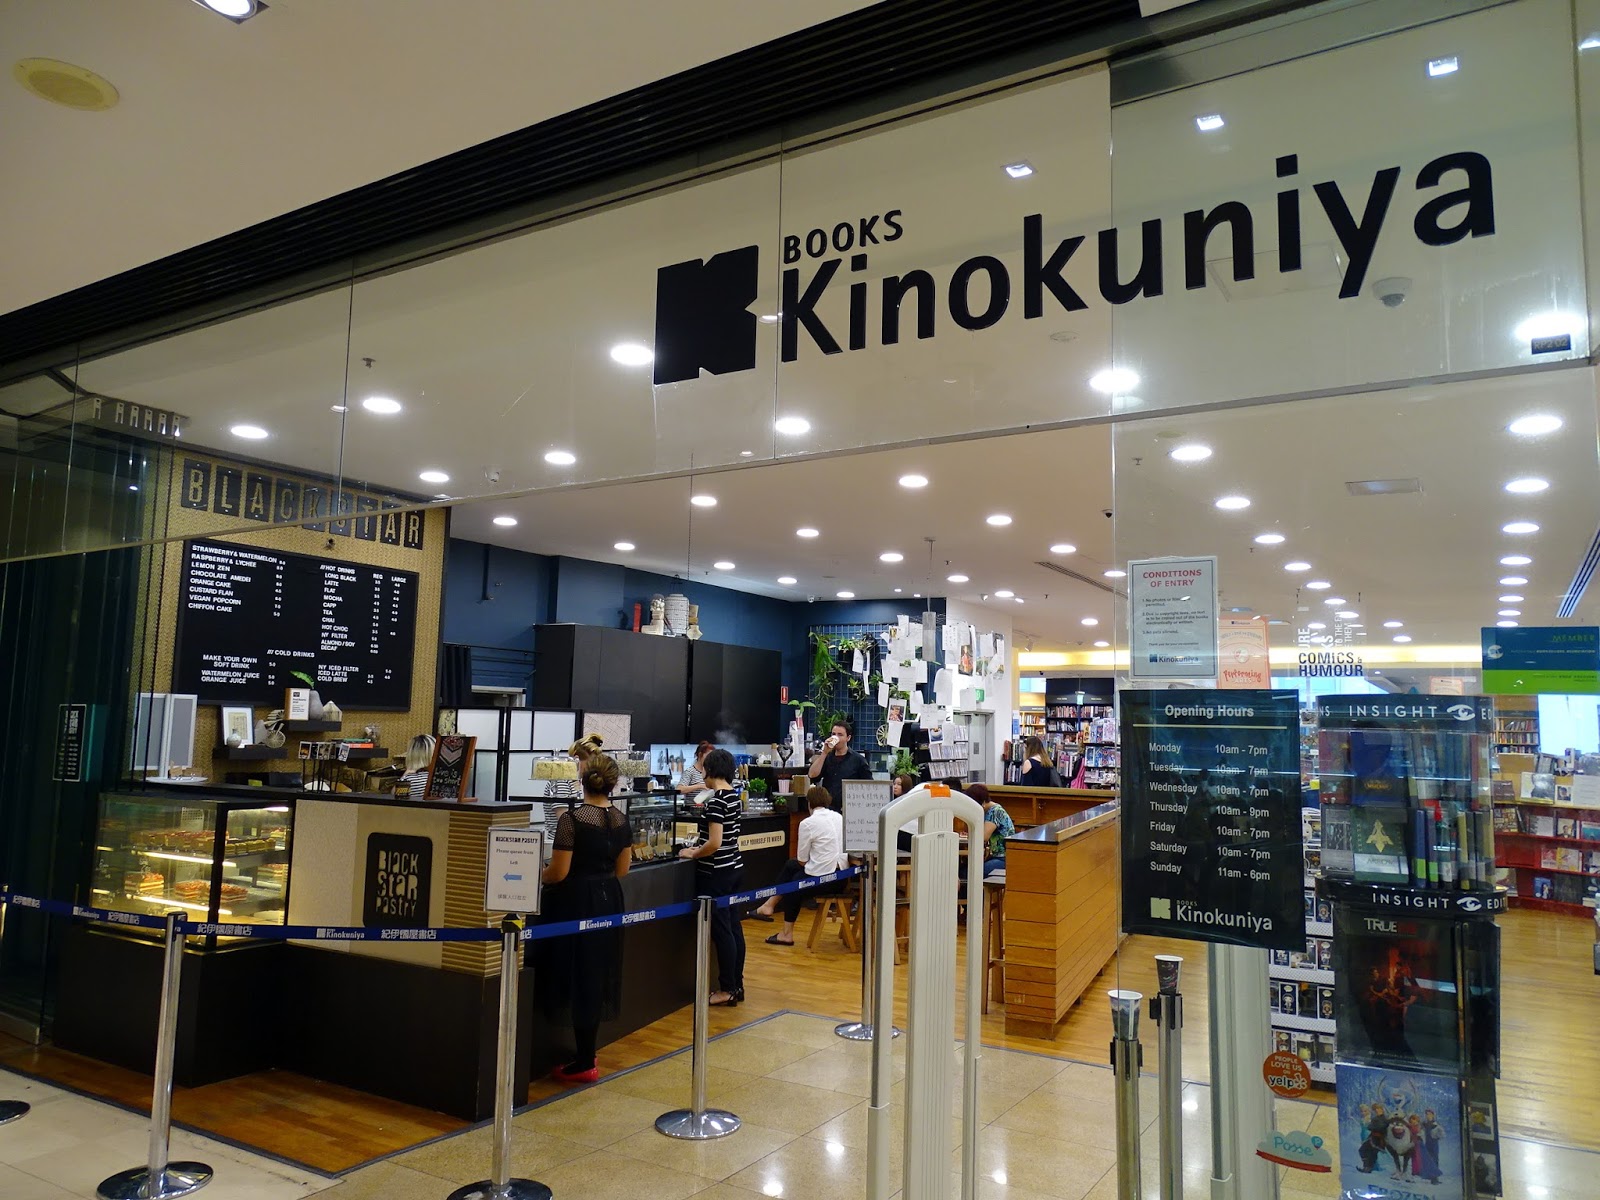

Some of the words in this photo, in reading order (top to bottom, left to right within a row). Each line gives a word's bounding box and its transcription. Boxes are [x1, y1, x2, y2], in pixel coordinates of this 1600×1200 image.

[783, 209, 904, 265] BOOKS
[780, 150, 1496, 364] Kinokuniya
[239, 551, 277, 563] WATERMELON
[191, 561, 215, 570] LEMON
[235, 560, 257, 568] LYCHEE
[190, 570, 227, 579] CHOCOLATE
[230, 574, 251, 582] AMEDEI
[324, 572, 339, 580] LONG
[340, 574, 357, 582] BLACK
[1142, 569, 1202, 579] CONDITIONS
[189, 577, 214, 586] ORANGE
[1150, 580, 1162, 588] OF
[1164, 579, 1195, 587] ENTRY
[189, 586, 218, 595] CUSTARD
[189, 594, 211, 602] VEGAN
[212, 597, 242, 605] POPCORN
[323, 594, 343, 602] MOCHA
[188, 602, 215, 611] CHIFFON
[202, 654, 222, 662] MAKE
[292, 650, 315, 658] DRINKS
[1158, 655, 1199, 664] Kinokuniya
[201, 669, 242, 678] WATERMELON
[1299, 664, 1364, 677] HUMOUR
[1164, 704, 1214, 719] Opening
[1217, 704, 1255, 718] Hours
[1349, 705, 1437, 718] INSIGHT
[1149, 742, 1182, 755] Monday
[1215, 744, 1240, 755] 10am
[1248, 745, 1268, 757] 7pm
[1149, 762, 1184, 775] Tuesday
[1215, 764, 1240, 775] 10am
[1248, 765, 1269, 777] 7pm
[1149, 782, 1198, 794] Wednesday
[1216, 784, 1240, 796] 10am
[1249, 785, 1269, 798] 7pm
[1150, 801, 1188, 815] Thursday
[1216, 805, 1241, 816] 10am
[1249, 806, 1270, 818] 9pm
[1150, 821, 1176, 835] Friday
[1216, 826, 1241, 837] 10am
[1249, 827, 1270, 839] 7pm
[1150, 841, 1187, 855] Saturday
[1217, 846, 1242, 858] 10am
[1250, 847, 1271, 860] 7pm
[1150, 861, 1182, 875] Sunday
[1217, 867, 1242, 879] 11am
[1250, 868, 1271, 881] 6pm
[1176, 899, 1198, 907] BOOKS
[1372, 892, 1450, 909] INSIGHT
[1176, 904, 1273, 932] Kinokuniya
[1364, 917, 1398, 933] TRUE
[1274, 1055, 1299, 1064] PEOPLE
[1270, 1061, 1291, 1070] LOVE
[1292, 1064, 1303, 1072] US
[1268, 1074, 1295, 1089] yelp
[1273, 1136, 1315, 1157] Posse
